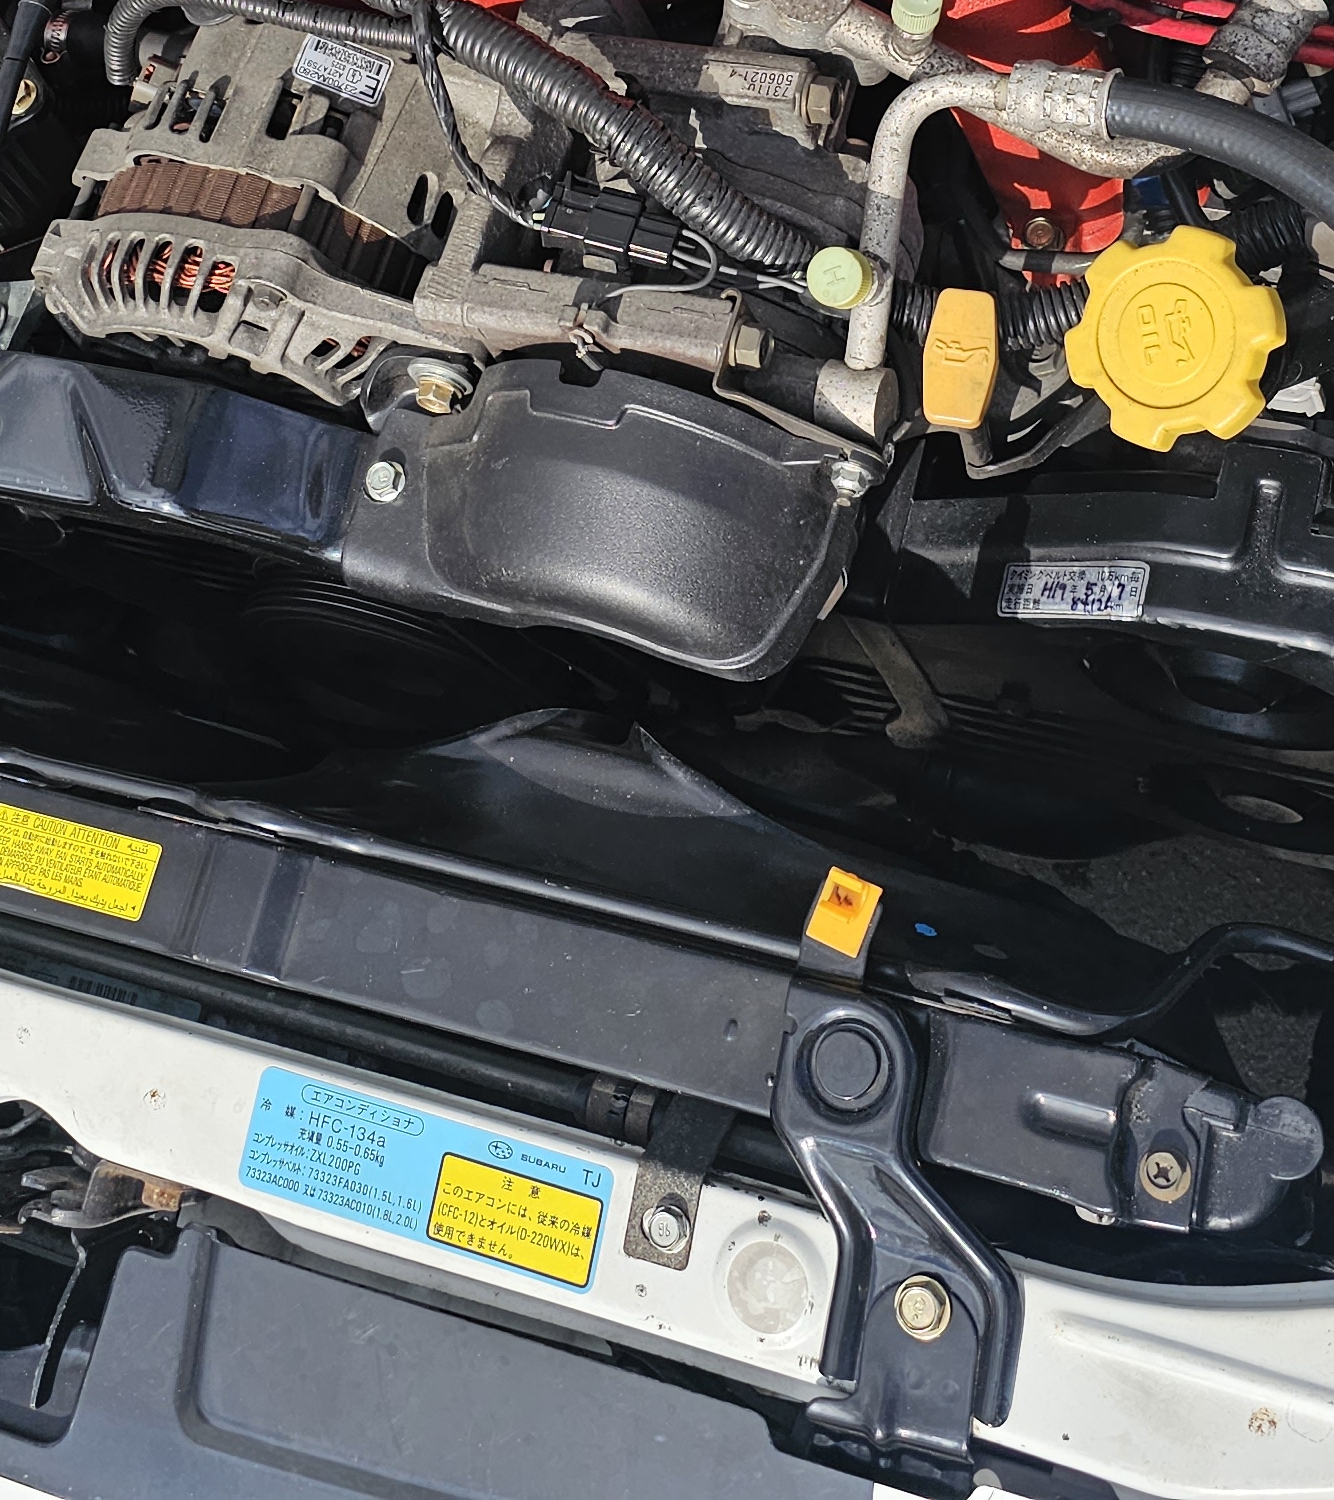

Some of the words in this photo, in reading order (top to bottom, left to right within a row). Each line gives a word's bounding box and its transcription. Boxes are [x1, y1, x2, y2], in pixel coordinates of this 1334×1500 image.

[1136, 304, 1161, 366] OIL
[1129, 587, 1137, 596] 日
[32, 816, 68, 835] CAUTION
[68, 826, 120, 849] ATTENTION
[11, 838, 34, 852] HANDS
[55, 850, 68, 861] FAN
[68, 853, 94, 868] STARTS
[34, 855, 45, 865] DU
[38, 867, 50, 878] PAS
[50, 871, 63, 881] LES
[310, 1088, 415, 1131] エアコンディショナ
[307, 1111, 388, 1149] HFC-134a
[325, 1135, 386, 1167] 0.55-0.65kg
[244, 1166, 300, 1193] 73323AC000
[520, 1153, 567, 1174] SUBARU
[579, 1168, 602, 1189] TJ
[440, 1181, 593, 1240] このエアコンには、従来の冷媒
[431, 1221, 515, 1259] 使用できません。
